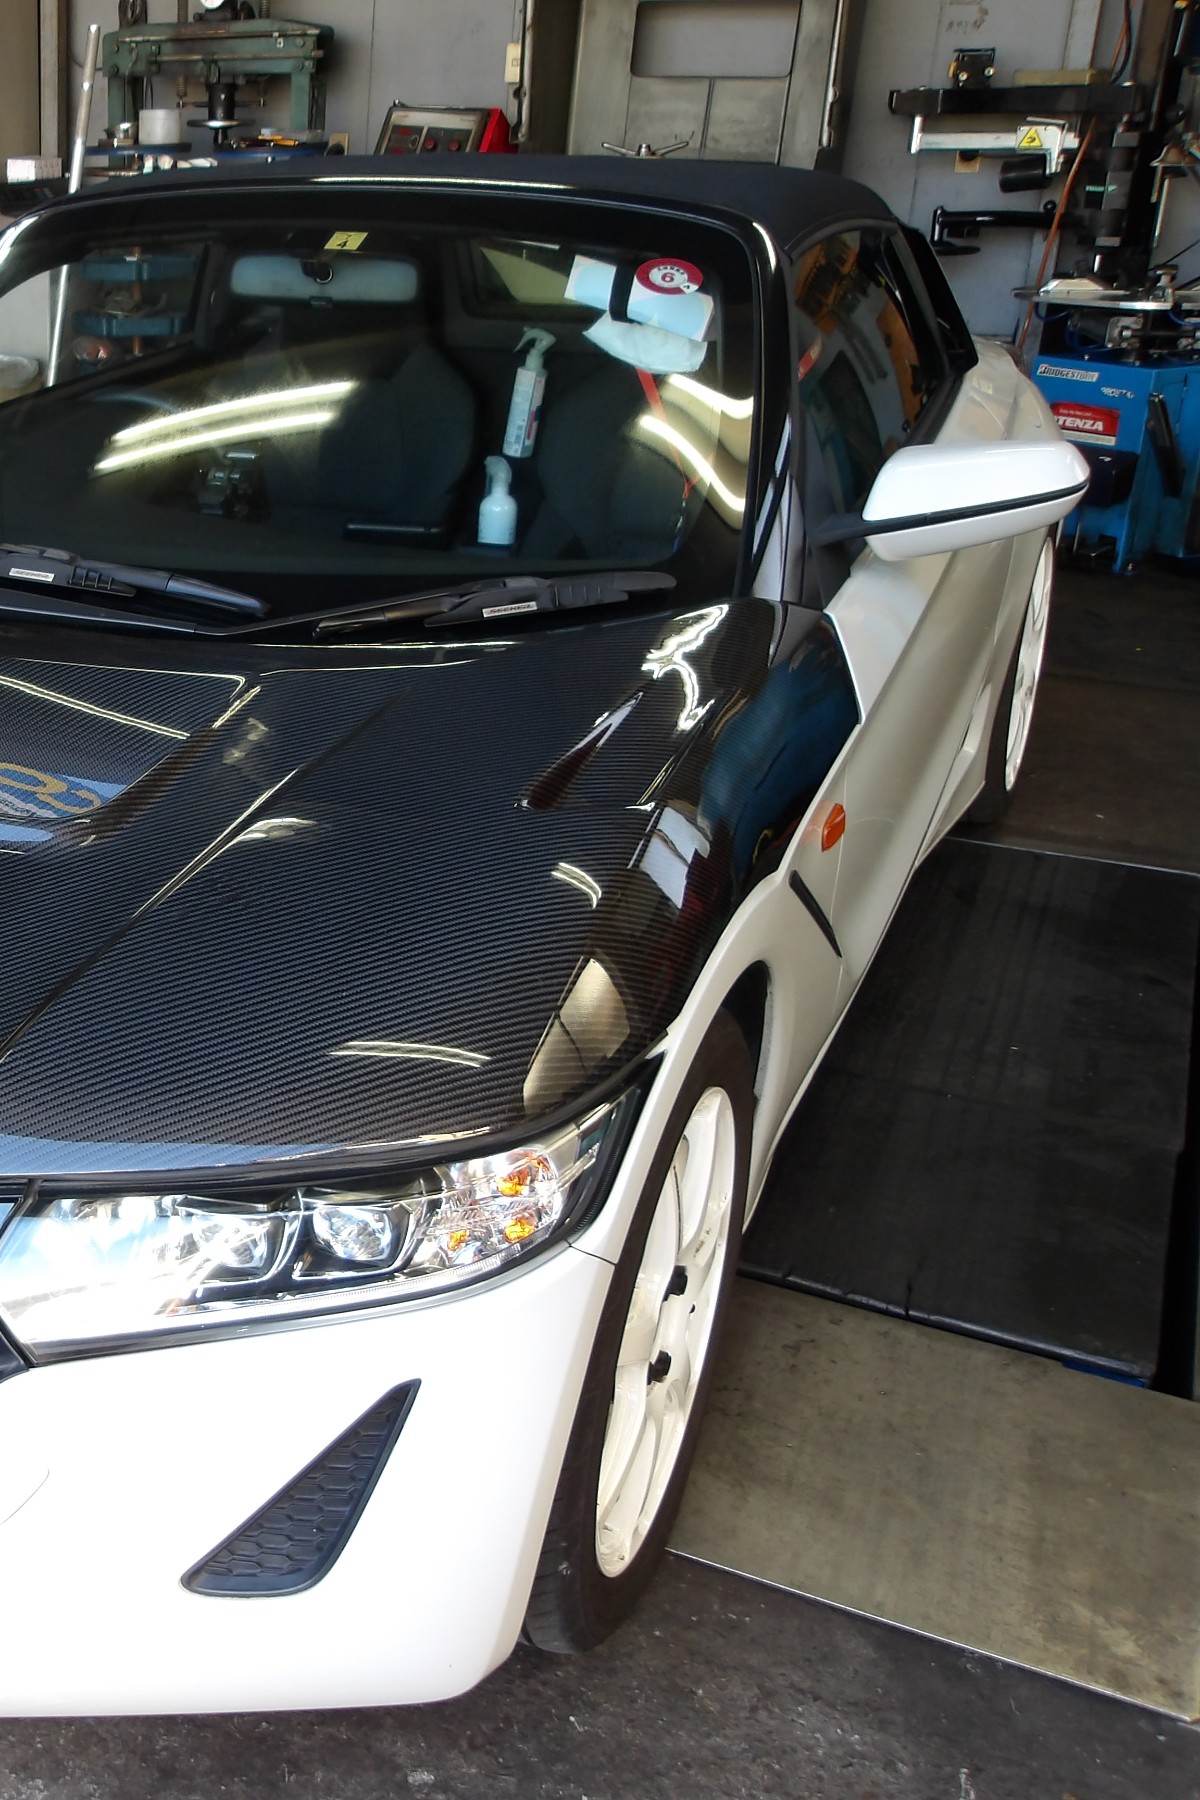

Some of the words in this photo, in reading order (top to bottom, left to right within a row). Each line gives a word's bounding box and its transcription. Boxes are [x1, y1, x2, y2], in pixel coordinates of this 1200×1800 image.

[661, 272, 675, 283] 6
[1038, 364, 1099, 382] BRIDGESTONE
[1054, 416, 1103, 431] TENZA
